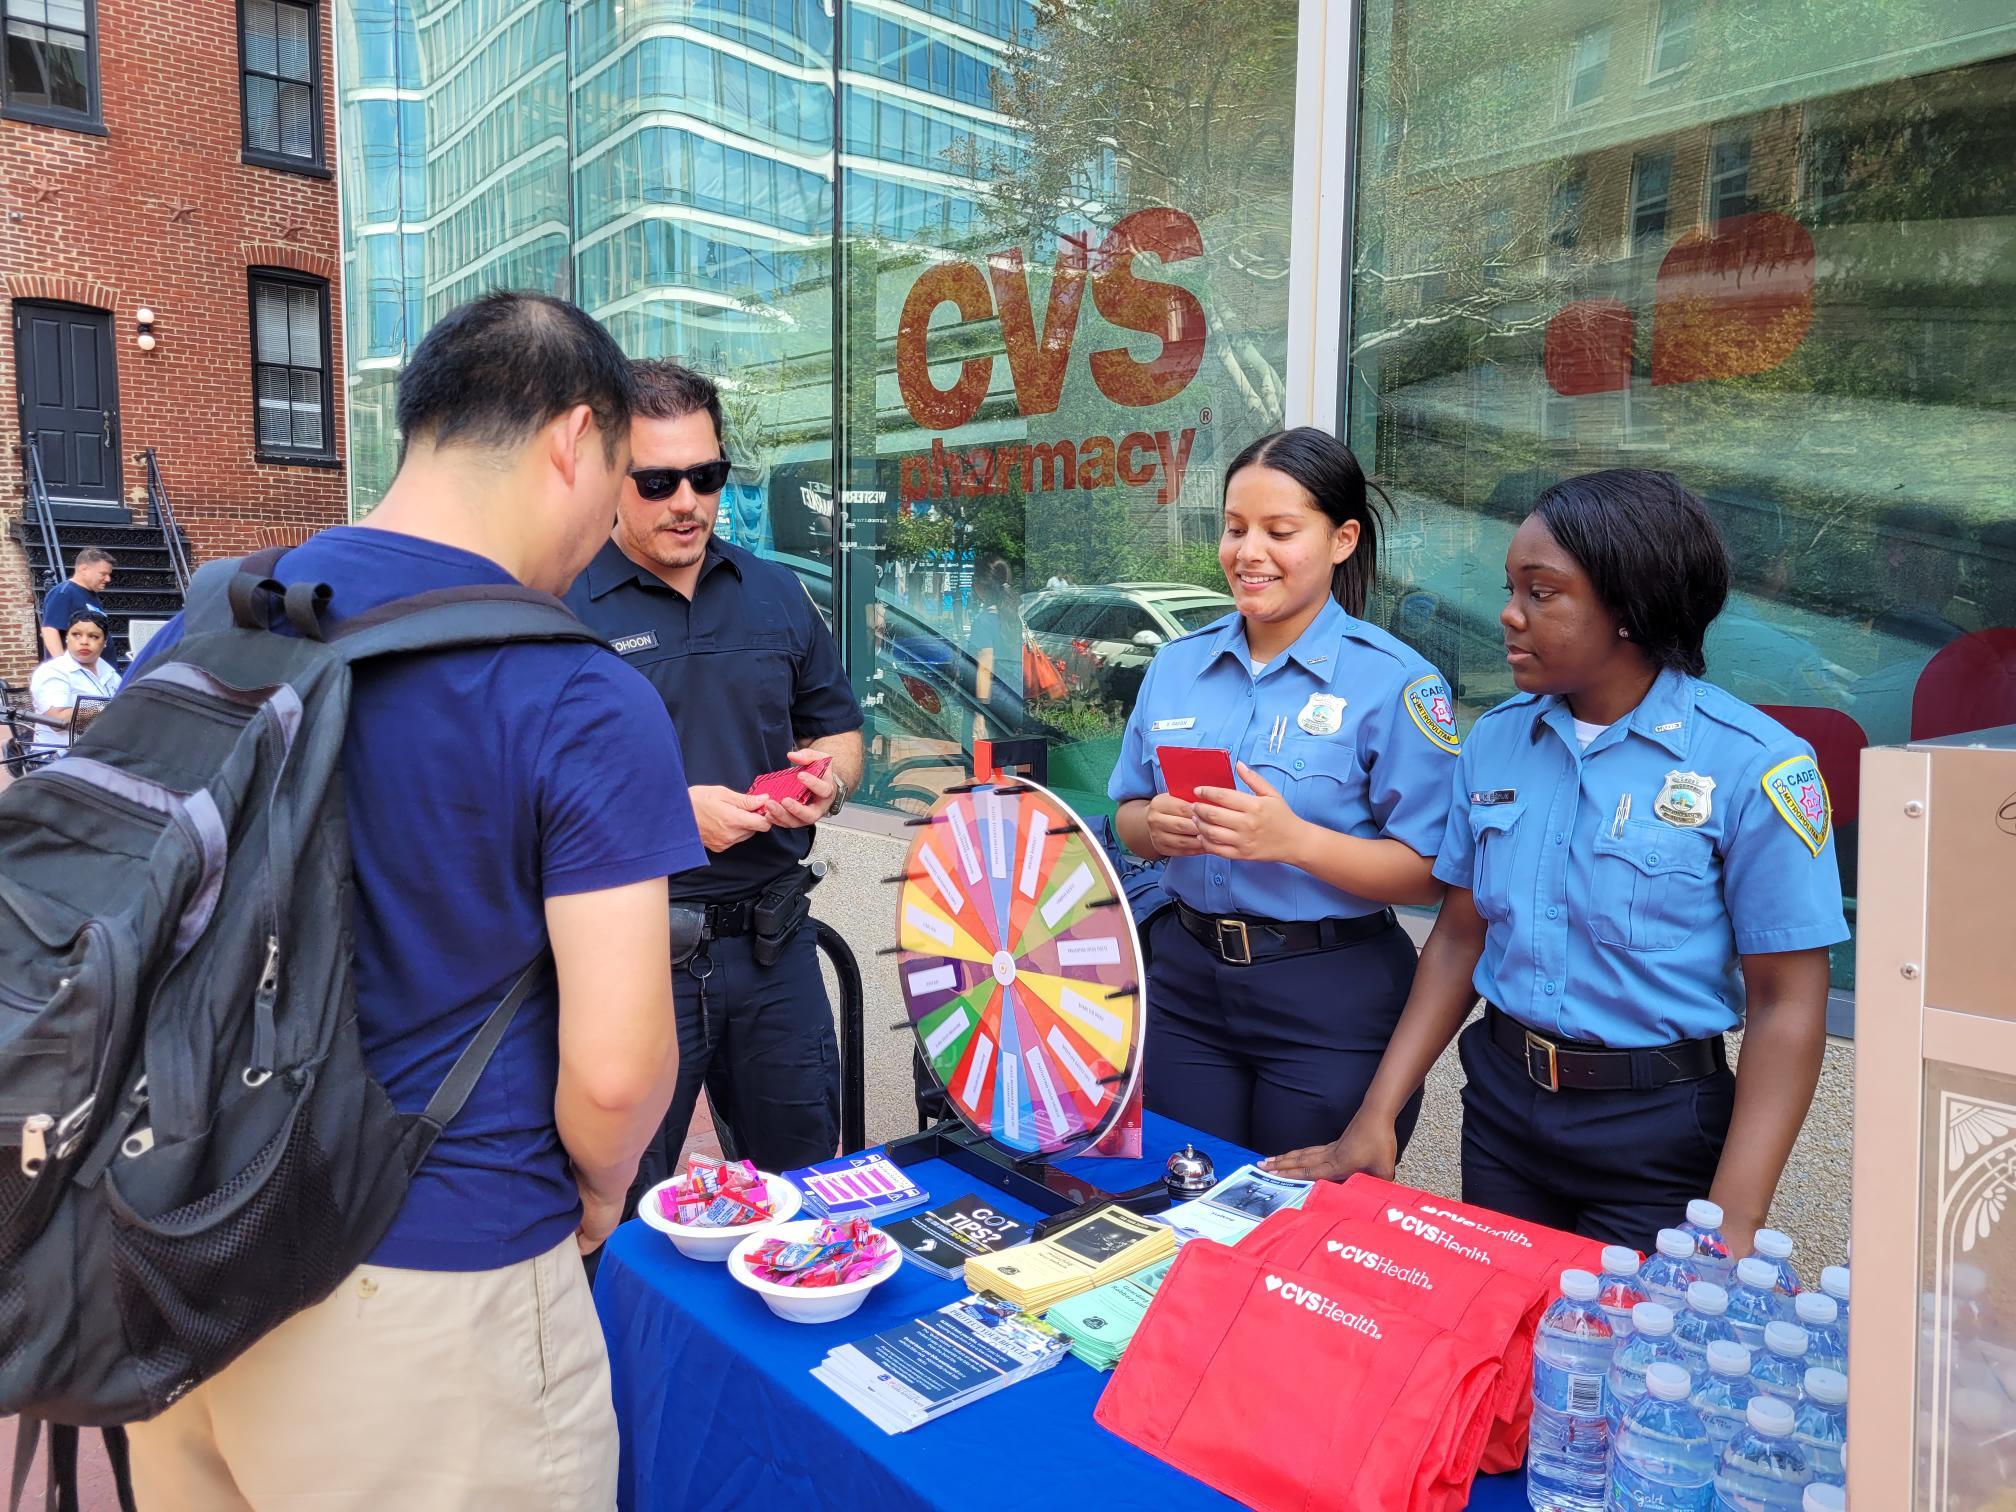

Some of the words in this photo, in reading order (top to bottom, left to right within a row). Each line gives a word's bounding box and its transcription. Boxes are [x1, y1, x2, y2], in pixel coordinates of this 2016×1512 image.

[897, 207, 1206, 430] CVS
[899, 428, 1197, 504] pharmacy
[611, 635, 652, 651] OHOON
[1416, 703, 1452, 742] METROPOLITAN
[1783, 791, 1820, 841] METROPOLITAN
[946, 1212, 1002, 1244] TIPS?
[972, 1208, 1020, 1232] GOT
